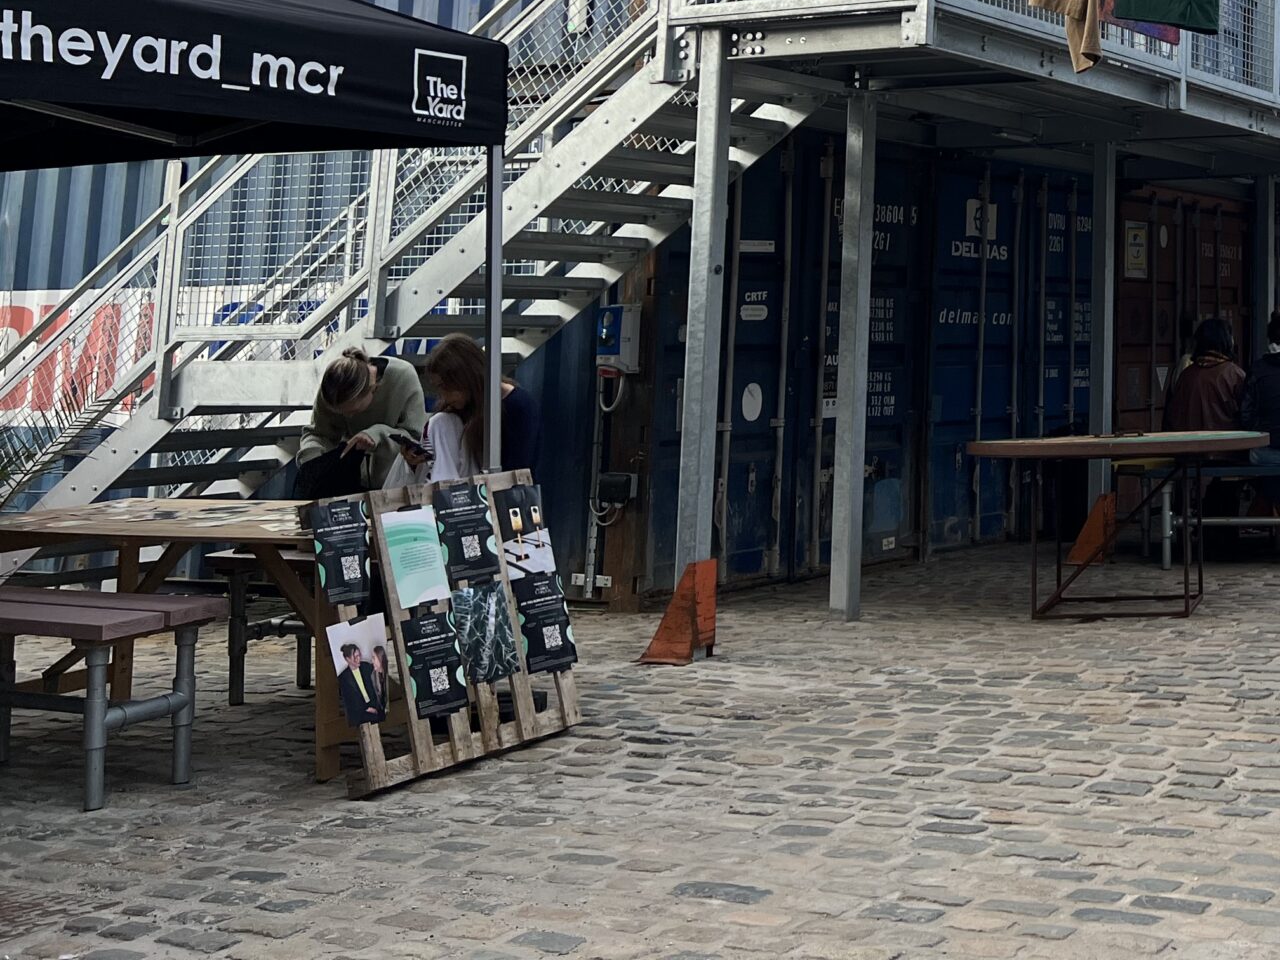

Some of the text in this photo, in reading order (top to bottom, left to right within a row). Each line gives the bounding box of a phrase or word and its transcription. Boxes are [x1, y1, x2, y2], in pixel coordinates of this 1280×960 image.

[0, 9, 345, 97] theyard_mcr
[425, 75, 459, 100] The
[426, 96, 466, 121] Yard
[416, 117, 463, 128] MANCHESTER
[745, 291, 768, 302] CRTF
